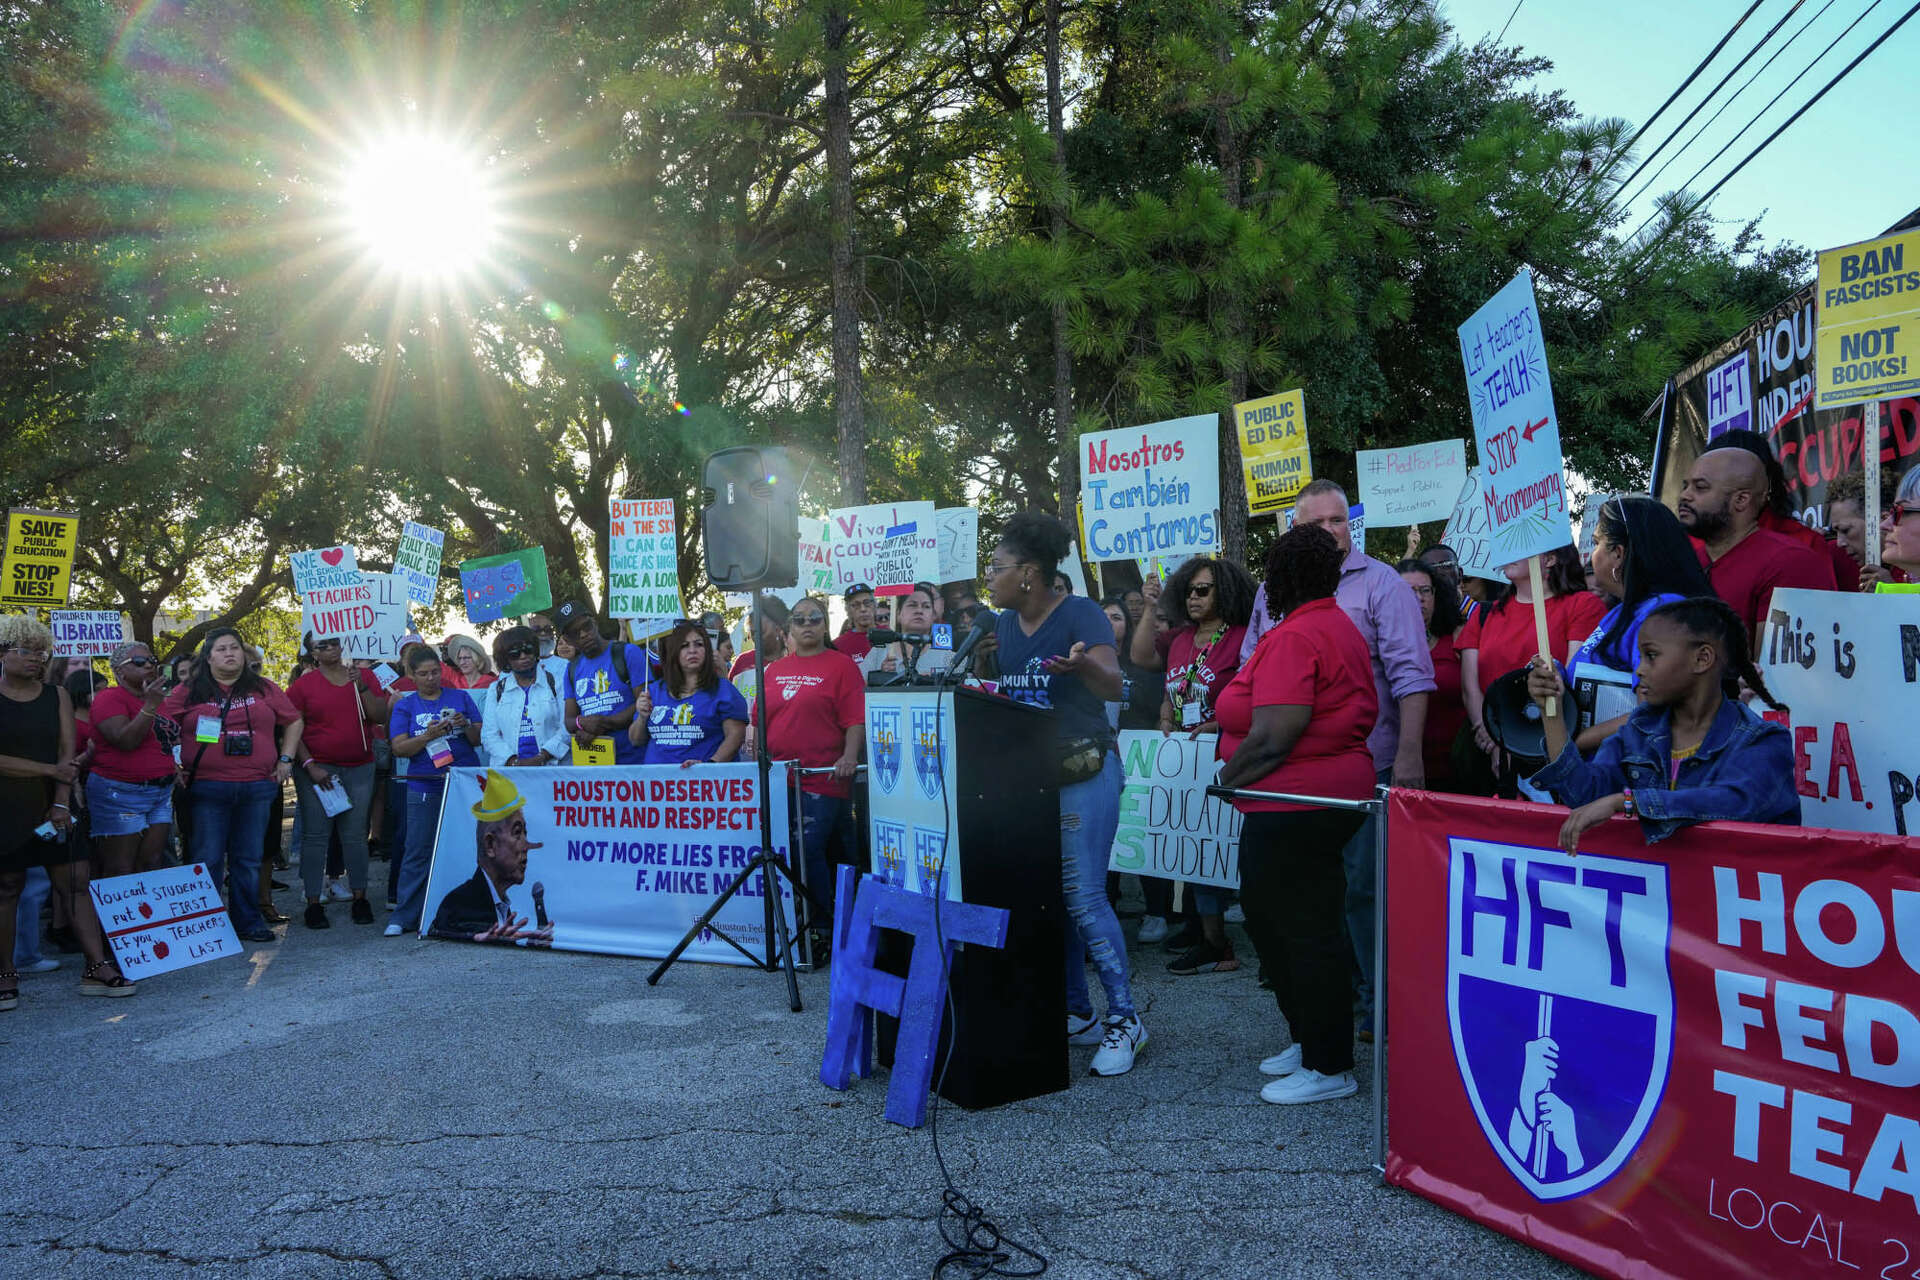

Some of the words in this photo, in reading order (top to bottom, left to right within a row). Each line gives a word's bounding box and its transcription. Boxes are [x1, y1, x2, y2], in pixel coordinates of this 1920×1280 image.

[1841, 243, 1904, 283] BAN
[1825, 271, 1920, 308] FASCISTS
[1463, 334, 1485, 376] Let
[1487, 306, 1533, 352] teachers
[1756, 303, 1813, 383] HOU
[1840, 326, 1900, 363] NOT
[1483, 349, 1531, 411] TEACH
[1832, 356, 1907, 385] BOOKS!
[1709, 358, 1746, 420] HFT
[1244, 402, 1295, 427] PUBLIC
[1758, 370, 1815, 434] INDEP
[1247, 427, 1266, 445] ED
[1269, 423, 1282, 439] IS
[1286, 420, 1297, 437] A
[1089, 435, 1184, 474] Nosotros
[1368, 449, 1457, 475] #RedForEd
[1486, 425, 1518, 475] STOP
[1250, 456, 1302, 480] HUMAN
[1088, 468, 1190, 511] También
[1256, 475, 1300, 497] RIGHT!
[1371, 484, 1406, 497] Support
[1413, 480, 1443, 493] Public
[612, 502, 673, 518] BUTTERFLY
[1386, 499, 1437, 515] Education
[1484, 472, 1564, 532] Micromanaging
[20, 519, 66, 538] SAVE
[612, 523, 624, 536] IN
[634, 521, 653, 534] THE
[658, 519, 675, 533] SKY
[837, 515, 884, 538] Viva
[1090, 509, 1220, 557] Contamos!
[1351, 518, 1364, 531] ESS
[13, 546, 66, 558] EDUCATION
[23, 537, 57, 547] PUBLIC
[400, 535, 424, 554] FULLY
[425, 542, 442, 560] FUND
[612, 539, 616, 551] I
[626, 538, 655, 550] CAN
[660, 537, 675, 550] GO
[892, 548, 909, 557] TEXAS
[914, 537, 936, 550] iva
[13, 563, 59, 580] STOP
[293, 553, 318, 569] WE
[297, 569, 313, 579] OUR
[316, 565, 344, 577] SCHOOL
[395, 551, 422, 573] PUBLIC
[426, 560, 438, 576] ED
[610, 555, 638, 569] TWICE
[640, 556, 654, 569] AS
[657, 553, 676, 569] HIGH
[837, 561, 854, 584] la
[864, 567, 877, 582] u
[877, 557, 912, 573] PUBLIC
[14, 581, 54, 596] NES!
[296, 570, 363, 595] LIBRARIES
[611, 574, 638, 588] TAKE
[641, 574, 651, 588] A
[655, 573, 678, 588] LOOK
[876, 570, 914, 585] SCHOOLS
[308, 586, 371, 605] TEACHERS
[610, 595, 628, 612] IT'S
[631, 596, 644, 612] IN
[645, 596, 651, 613] A
[656, 594, 679, 613] BOOK
[52, 612, 92, 621] CHILDREN
[98, 612, 120, 621] NEED
[312, 605, 374, 635] UNITED
[53, 623, 123, 641] LIBRARIES
[1770, 609, 1816, 670] This
[1832, 622, 1856, 679] is
[53, 645, 73, 655] NOT
[76, 644, 100, 655] SPIN
[102, 642, 122, 653] BIK
[872, 712, 900, 742] HFT
[913, 712, 945, 742] HFT
[579, 744, 606, 753] VOUCHERS
[878, 731, 894, 754] 50
[921, 733, 938, 758] 50
[1124, 738, 1217, 781] NOT
[553, 781, 645, 801] HOUSTON
[650, 779, 754, 802] DESERVES
[553, 806, 616, 827] TRUTH
[620, 807, 660, 829] AND
[665, 808, 763, 830] RESPECT!
[877, 824, 905, 857] HFT
[916, 832, 945, 862] HFT
[567, 840, 608, 863] NOT
[610, 842, 668, 865] MORE
[672, 844, 713, 867] LIES
[883, 846, 900, 870] 50
[1115, 828, 1241, 883] STUDENT
[923, 855, 940, 880] 50
[90, 883, 122, 906] You
[123, 881, 148, 900] can't
[152, 881, 212, 901] STUDENTS
[636, 869, 649, 892] F.
[655, 870, 708, 895] MIKE
[113, 907, 136, 925] put
[169, 897, 209, 917] FIRST
[1461, 852, 1647, 988] HFT
[133, 934, 152, 948] you
[167, 916, 226, 941] TEACHERS
[125, 952, 151, 968] put
[189, 939, 223, 959] LAST
[1714, 969, 1920, 1088] FED
[1713, 1070, 1920, 1216] TEA
[1709, 1178, 1861, 1270] LOCAL
